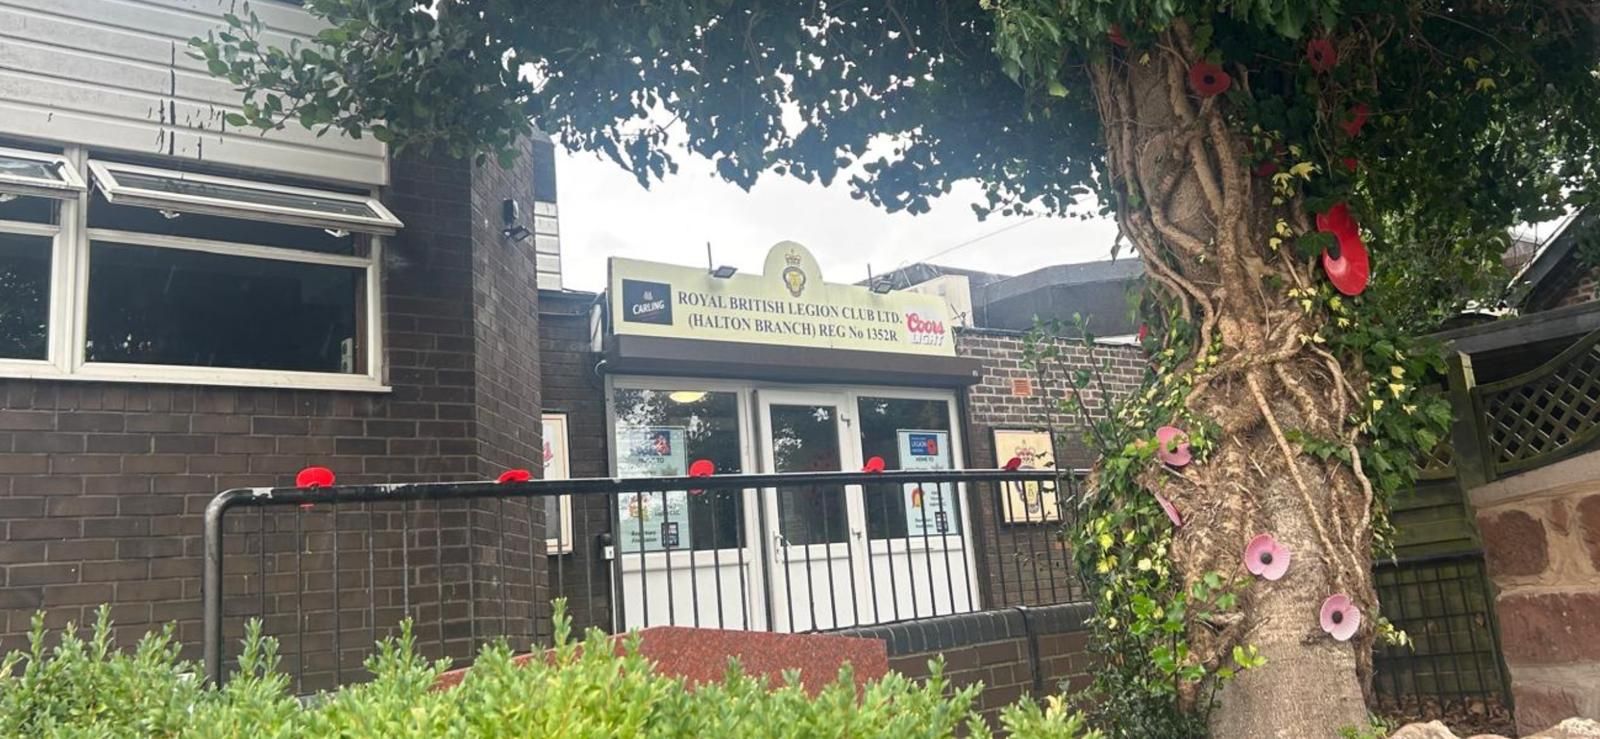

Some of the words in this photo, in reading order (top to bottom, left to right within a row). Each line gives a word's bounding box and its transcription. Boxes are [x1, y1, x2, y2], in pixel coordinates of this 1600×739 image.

[632, 300, 665, 315] CARLING
[678, 291, 727, 309] ROYAL
[730, 297, 784, 314] BRITISH
[789, 302, 839, 318] LEGION
[842, 306, 875, 321] CLUB
[877, 311, 903, 324] LTD.
[688, 313, 751, 331] (HALTON
[755, 321, 816, 338] BRANCH)
[819, 325, 846, 337] REG
[849, 326, 864, 339] No
[867, 327, 898, 342] 1352R
[905, 313, 945, 335] Coors
[912, 334, 945, 346] LIGHT
